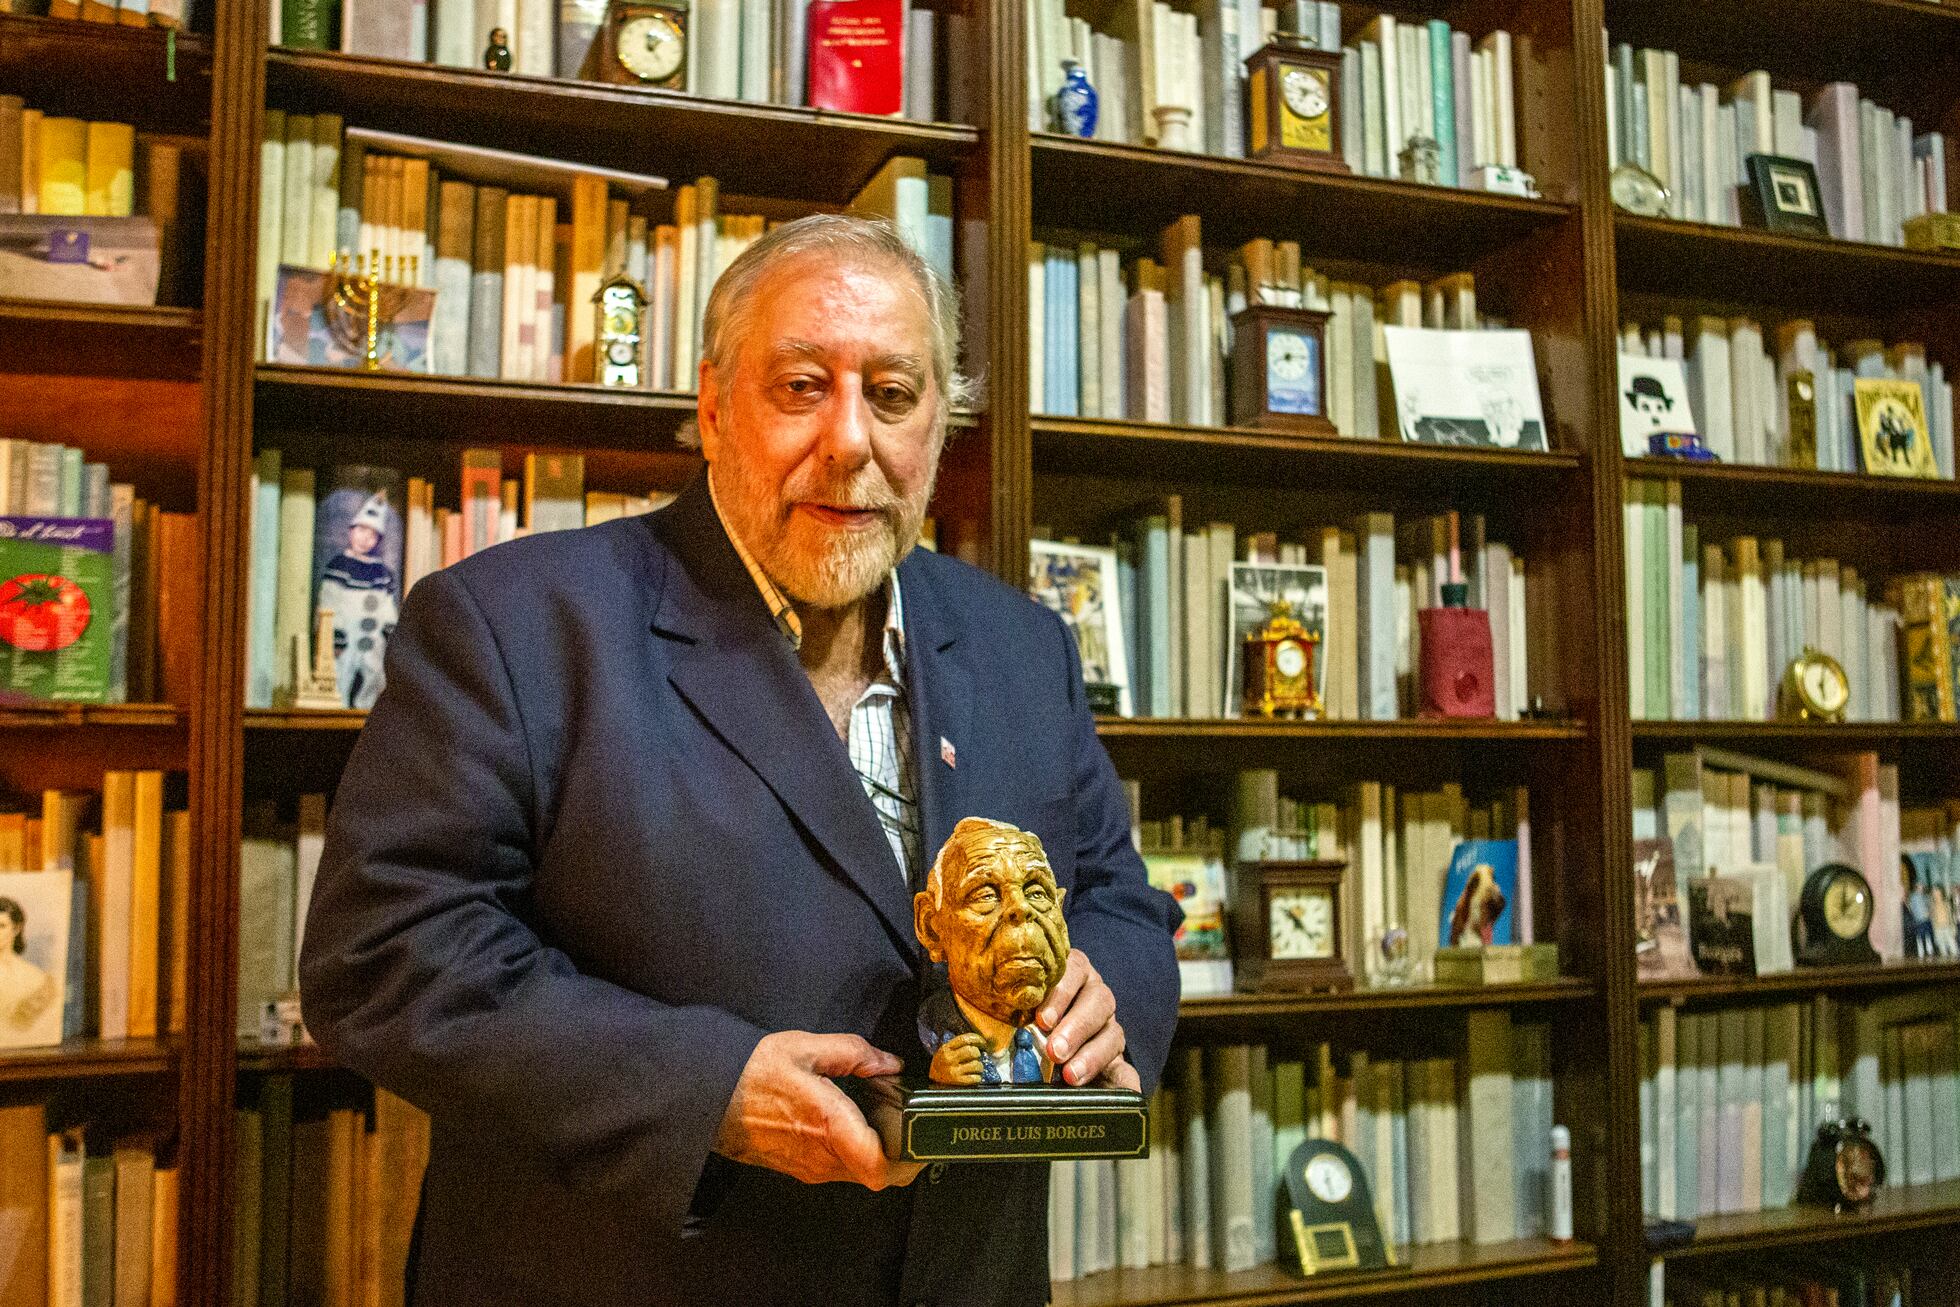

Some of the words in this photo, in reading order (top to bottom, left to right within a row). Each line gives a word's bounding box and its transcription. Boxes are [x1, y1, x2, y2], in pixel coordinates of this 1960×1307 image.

[950, 1127, 1001, 1144] JORGE
[1006, 1126, 1041, 1140] LUIS
[1046, 1125, 1106, 1139] BORGES
